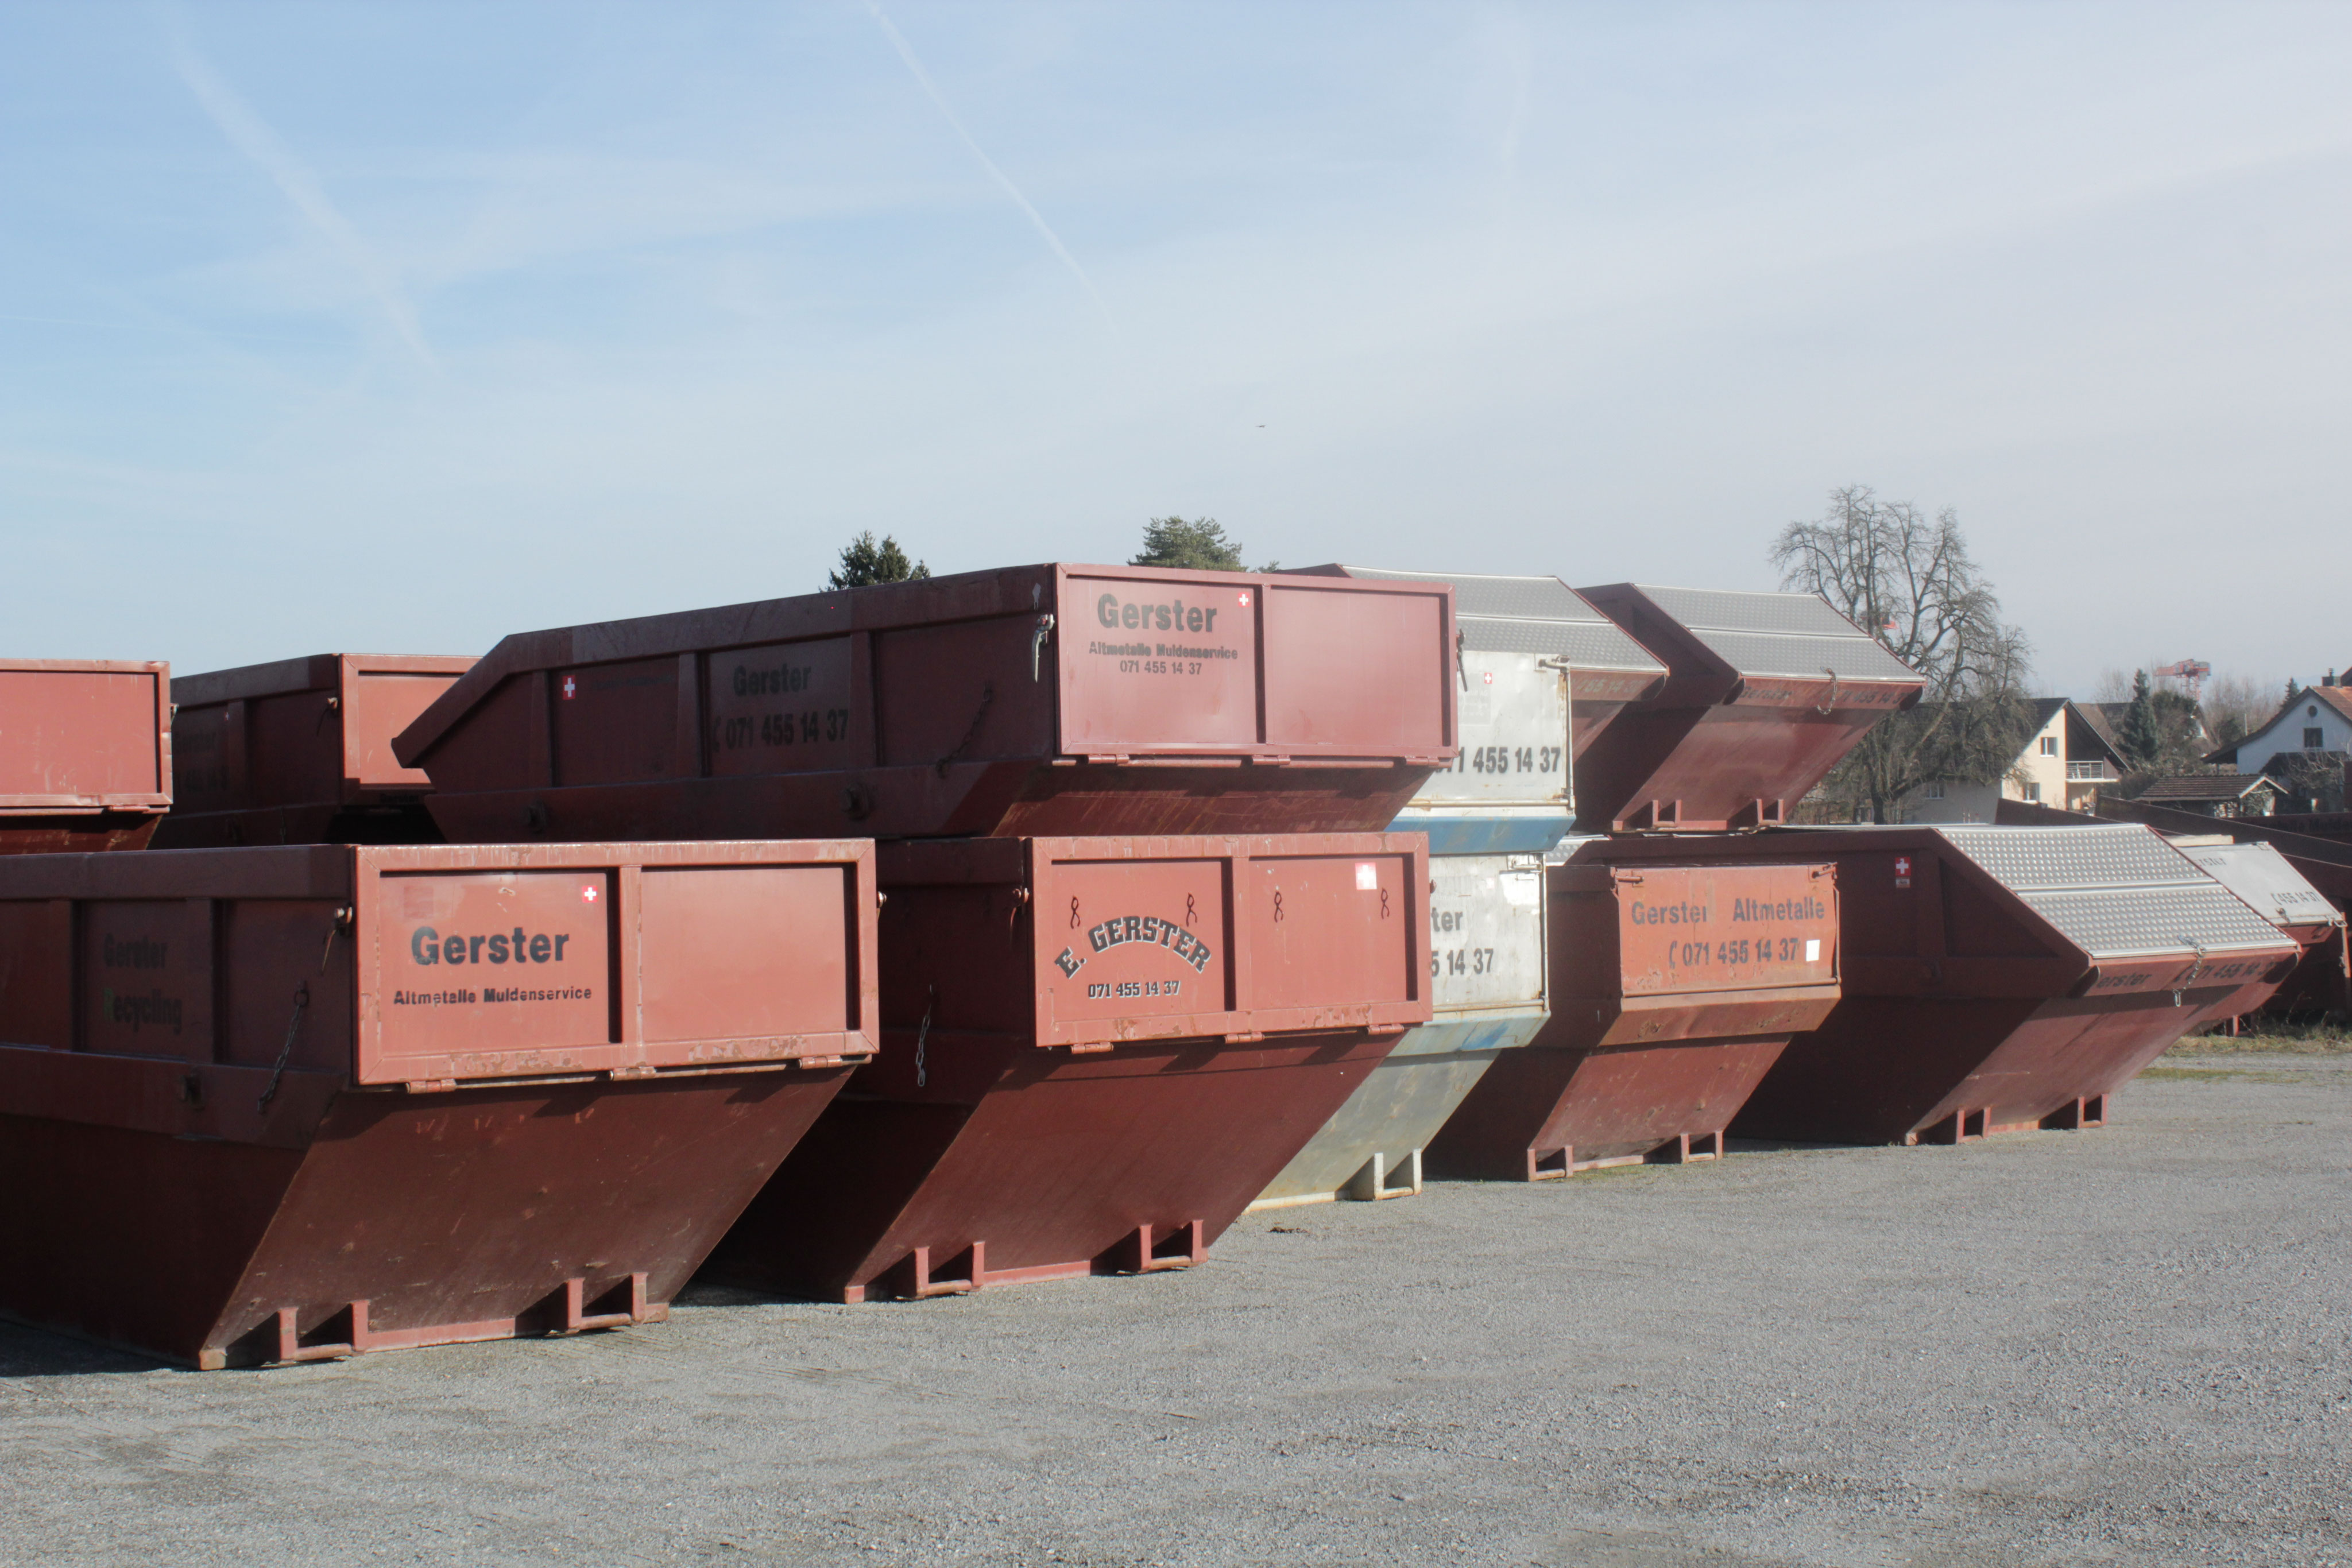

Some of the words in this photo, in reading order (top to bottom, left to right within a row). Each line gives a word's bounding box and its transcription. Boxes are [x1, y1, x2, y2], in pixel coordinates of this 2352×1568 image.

[1098, 593, 1217, 632] Gerster
[1089, 641, 1151, 656] Altmetalle
[1156, 644, 1237, 660] Muldenservice
[733, 663, 811, 696] Gerster
[1120, 660, 1139, 673] 071
[1144, 661, 1166, 674] 455
[1171, 662, 1183, 674] 14
[1189, 663, 1202, 675] 37
[726, 716, 753, 749] 071
[761, 713, 794, 745] 455
[800, 711, 819, 742] 14
[827, 708, 849, 741] 37
[1472, 747, 1508, 773] 455
[1515, 747, 1533, 773] 14
[1539, 747, 1561, 773] 37
[1732, 897, 1824, 922] Altmetalle
[2277, 892, 2298, 904] 455
[412, 926, 569, 966] Gerster
[1054, 946, 1087, 979] E.
[1087, 915, 1212, 973] GERSTER
[1682, 942, 1710, 966] 071
[1717, 940, 1748, 965] 455
[1755, 938, 1772, 962] 14
[1779, 938, 1799, 961] 37
[1446, 949, 1465, 975] 14
[1473, 947, 1494, 974] 37
[1088, 984, 1112, 998] 071
[1116, 982, 1141, 997] 455
[1144, 981, 1160, 996] 14
[1163, 980, 1181, 996] 37
[2098, 972, 2153, 988] erster
[394, 989, 476, 1005] Altmetalle
[483, 986, 592, 1003] Muldenservice
[103, 988, 183, 1035] Recycling
